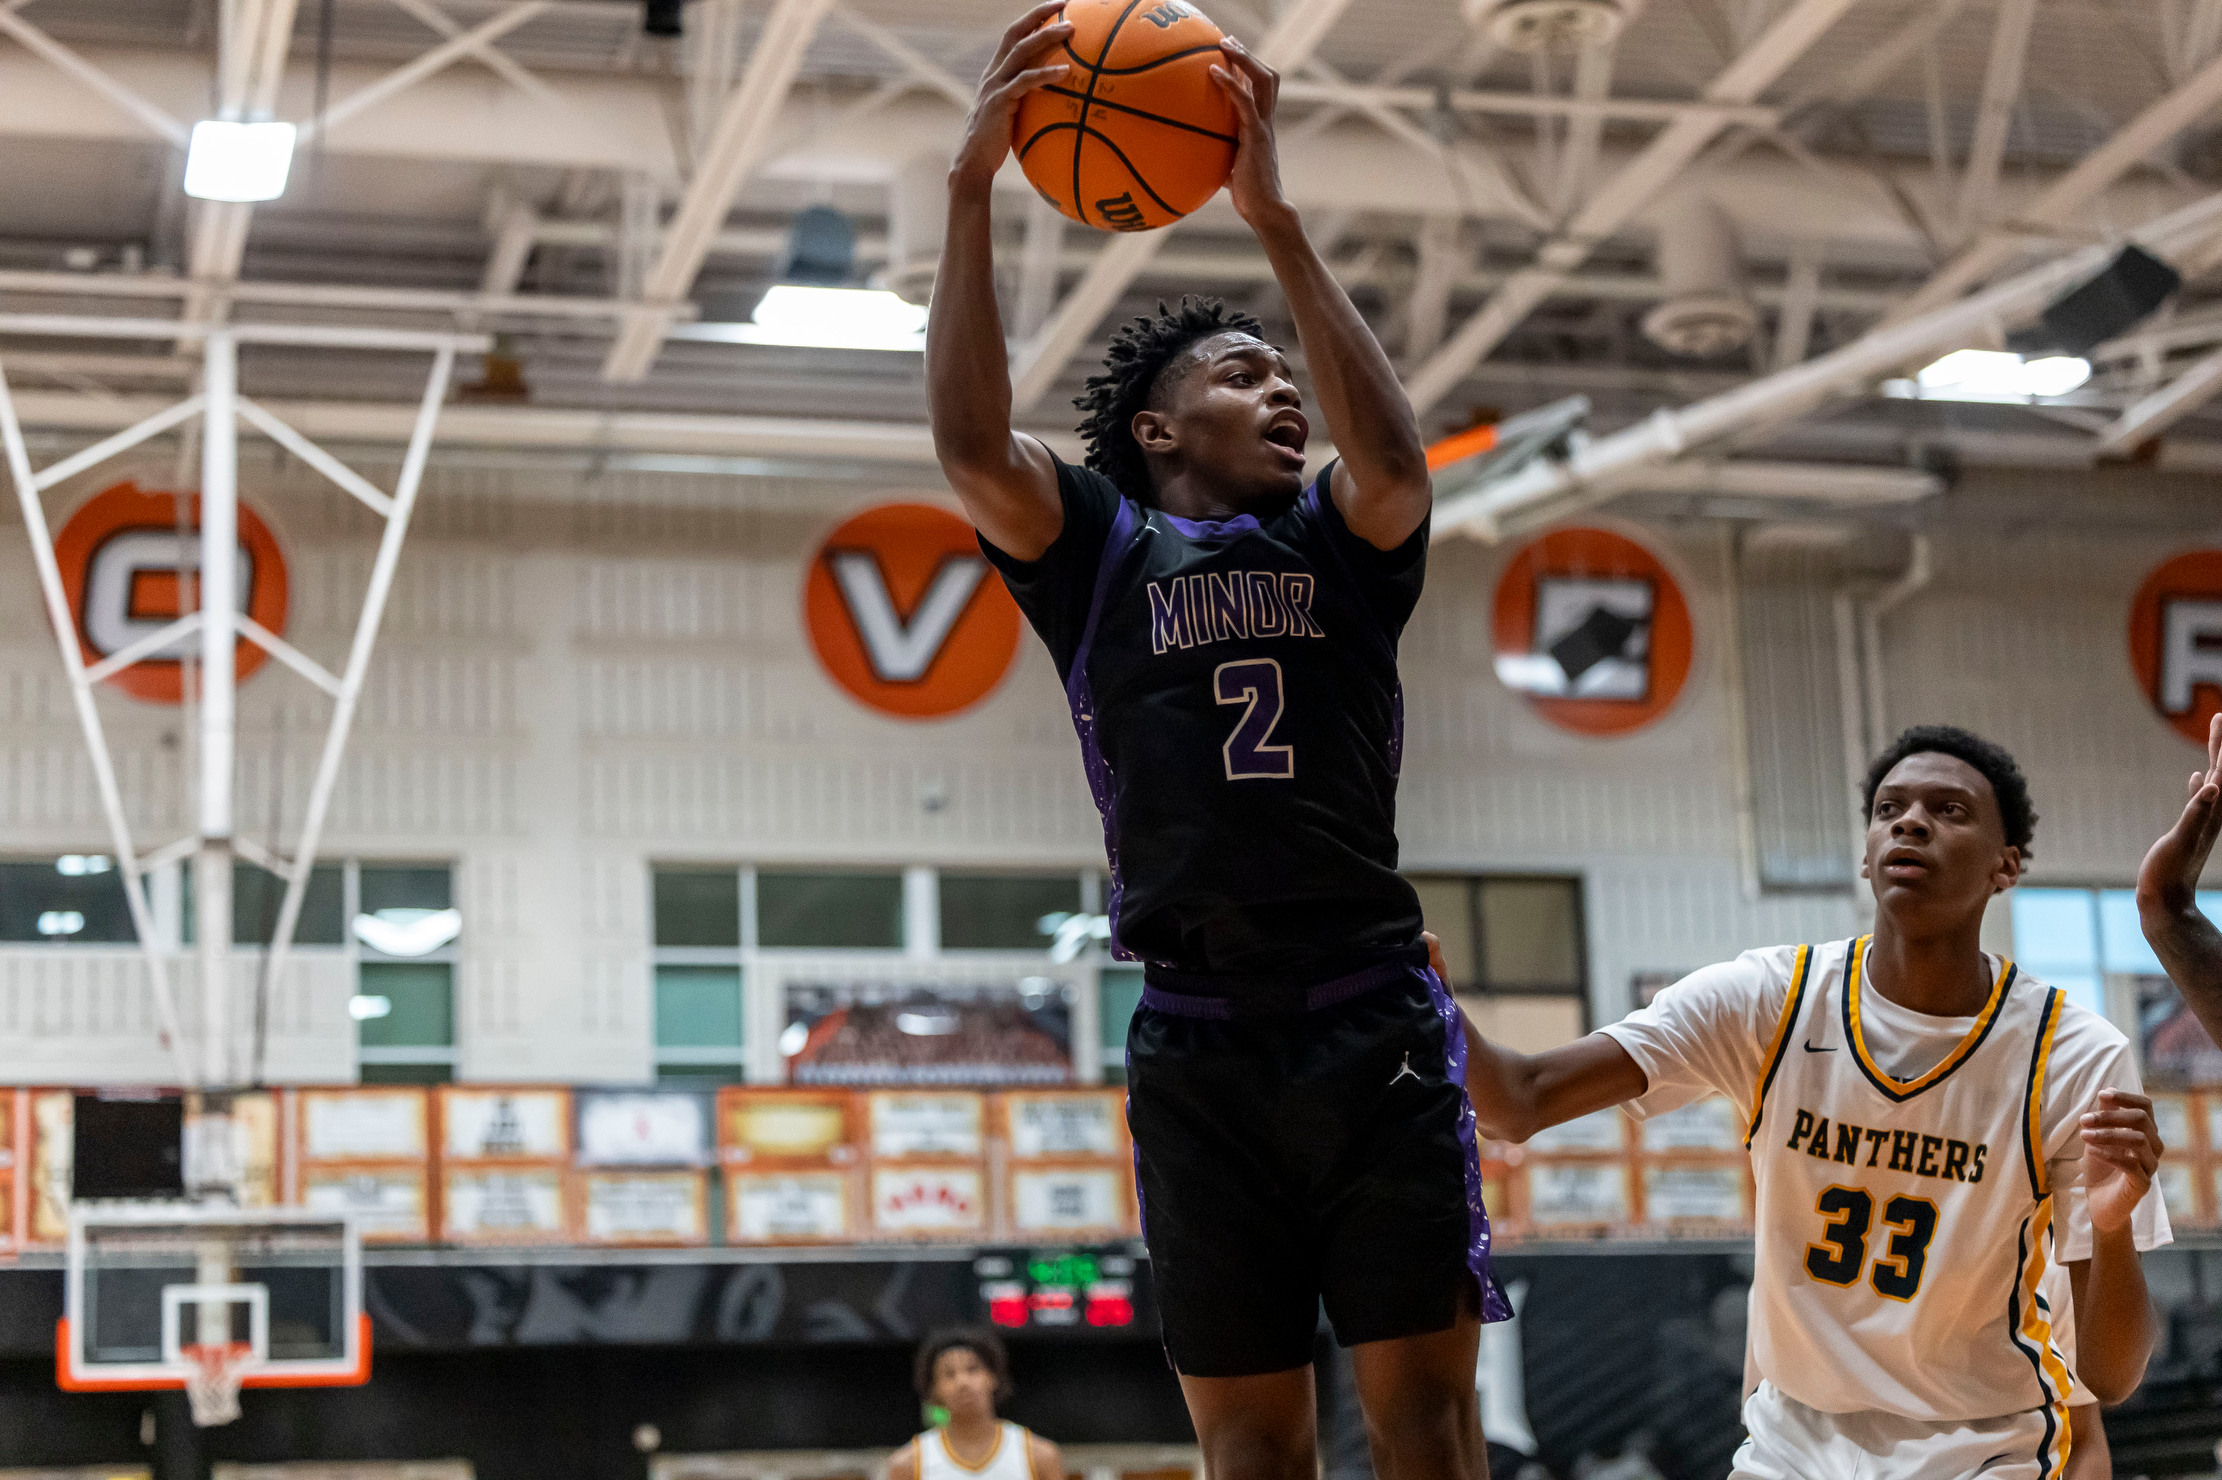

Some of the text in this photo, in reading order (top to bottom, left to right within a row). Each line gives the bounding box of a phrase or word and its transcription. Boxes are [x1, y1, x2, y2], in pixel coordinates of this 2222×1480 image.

[822, 546, 995, 684] V
[1147, 571, 1325, 655] MINOR
[1213, 658, 1294, 781] 2
[1786, 1108, 1989, 1184] PANTHERS
[1803, 1183, 1941, 1304] 33
